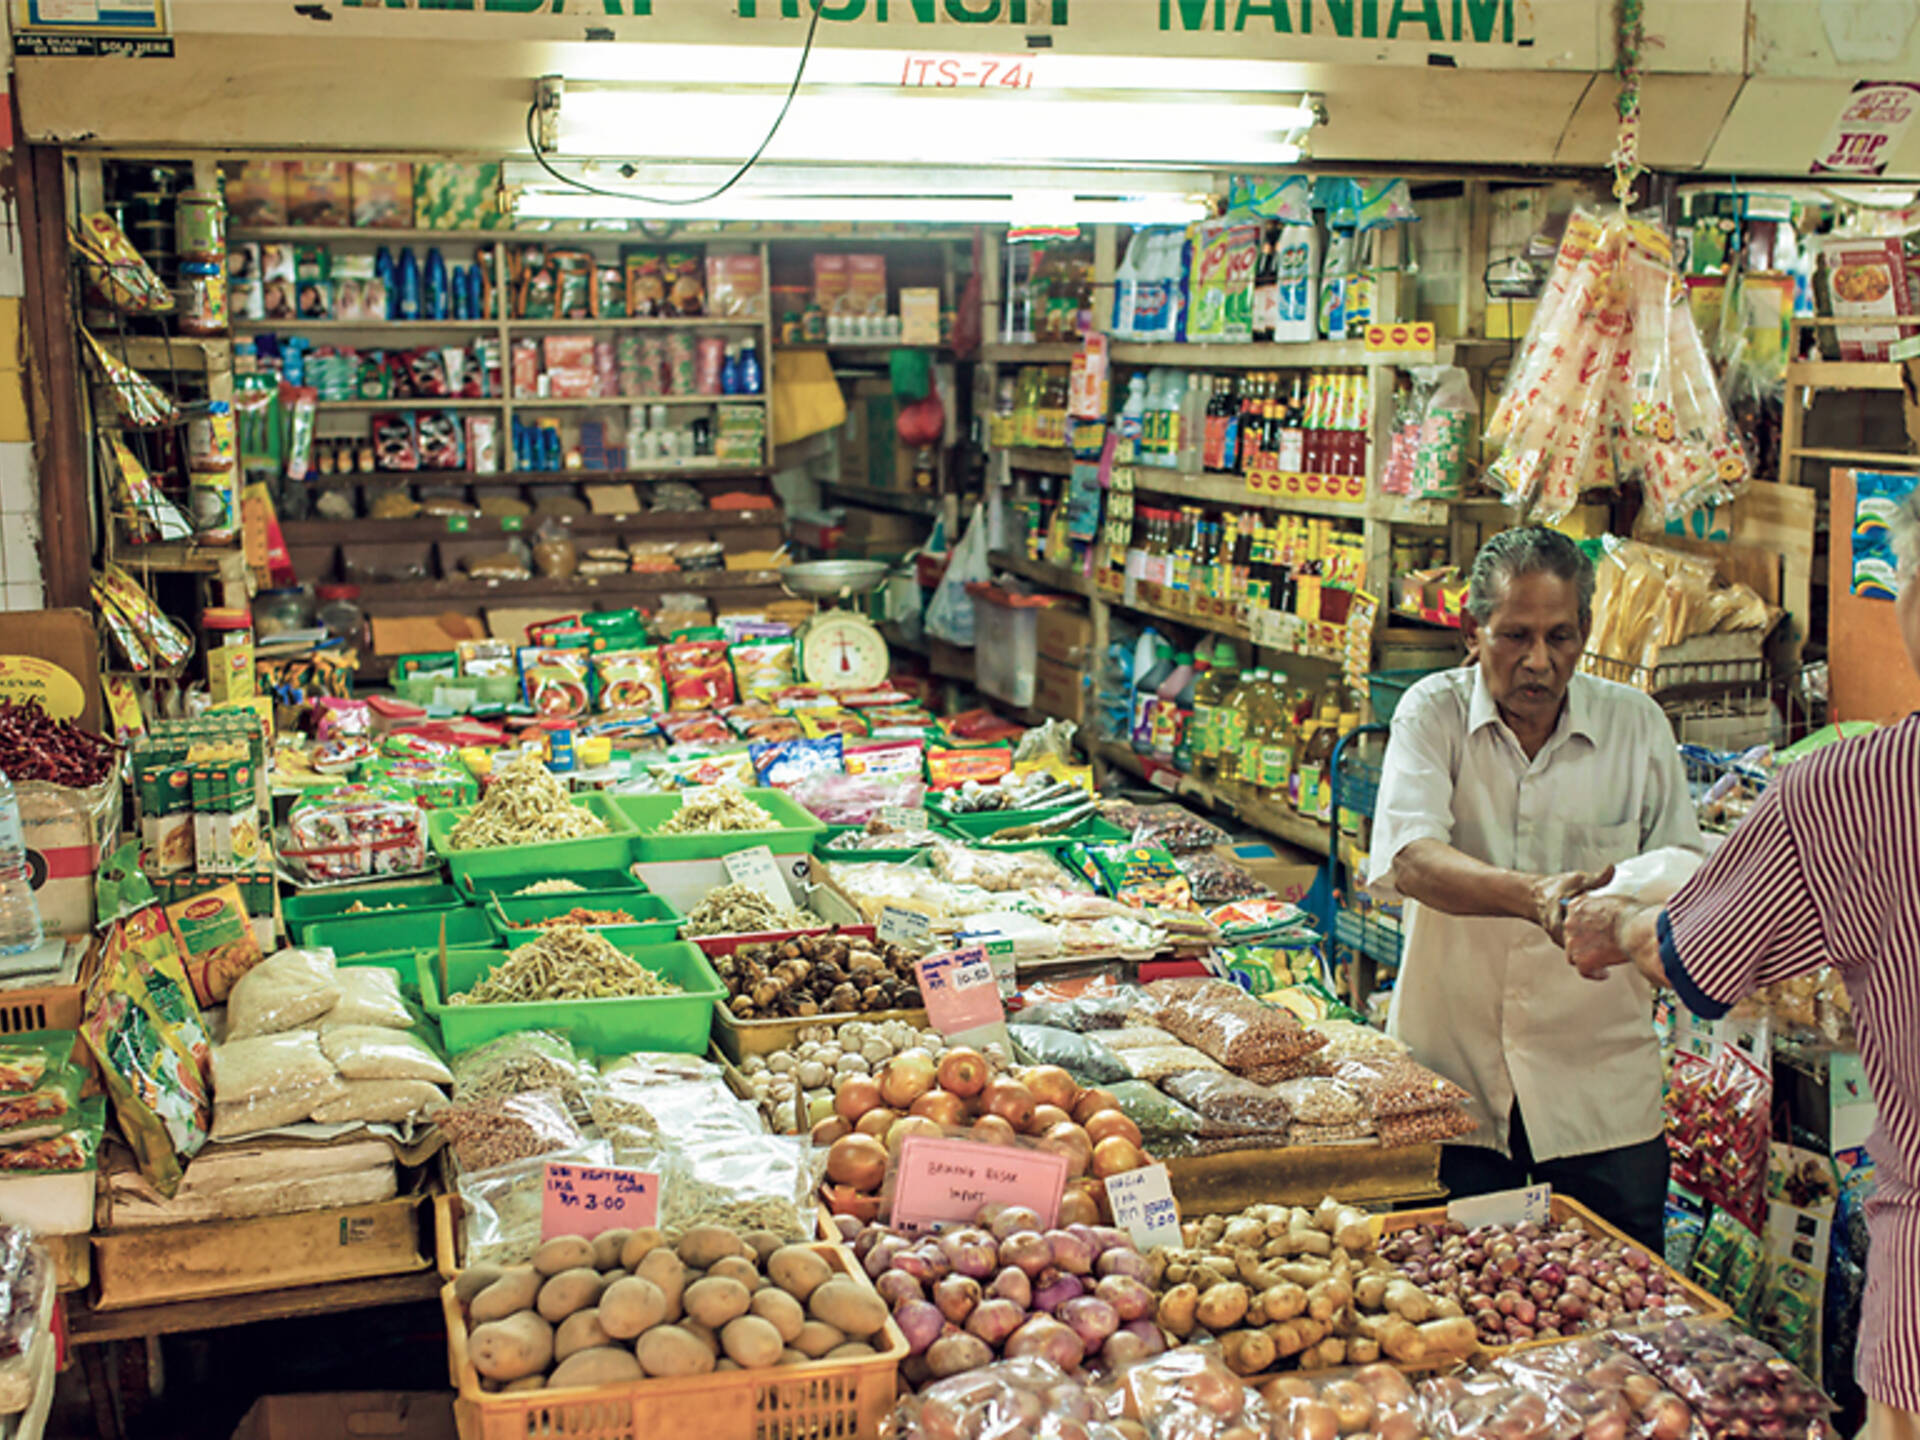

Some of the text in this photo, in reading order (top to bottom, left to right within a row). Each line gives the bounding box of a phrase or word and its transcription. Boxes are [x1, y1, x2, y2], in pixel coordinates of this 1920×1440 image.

[100, 41, 170, 53] SOLD HERE
[1836, 134, 1889, 153] TOP
[547, 1179, 574, 1191] 1KG
